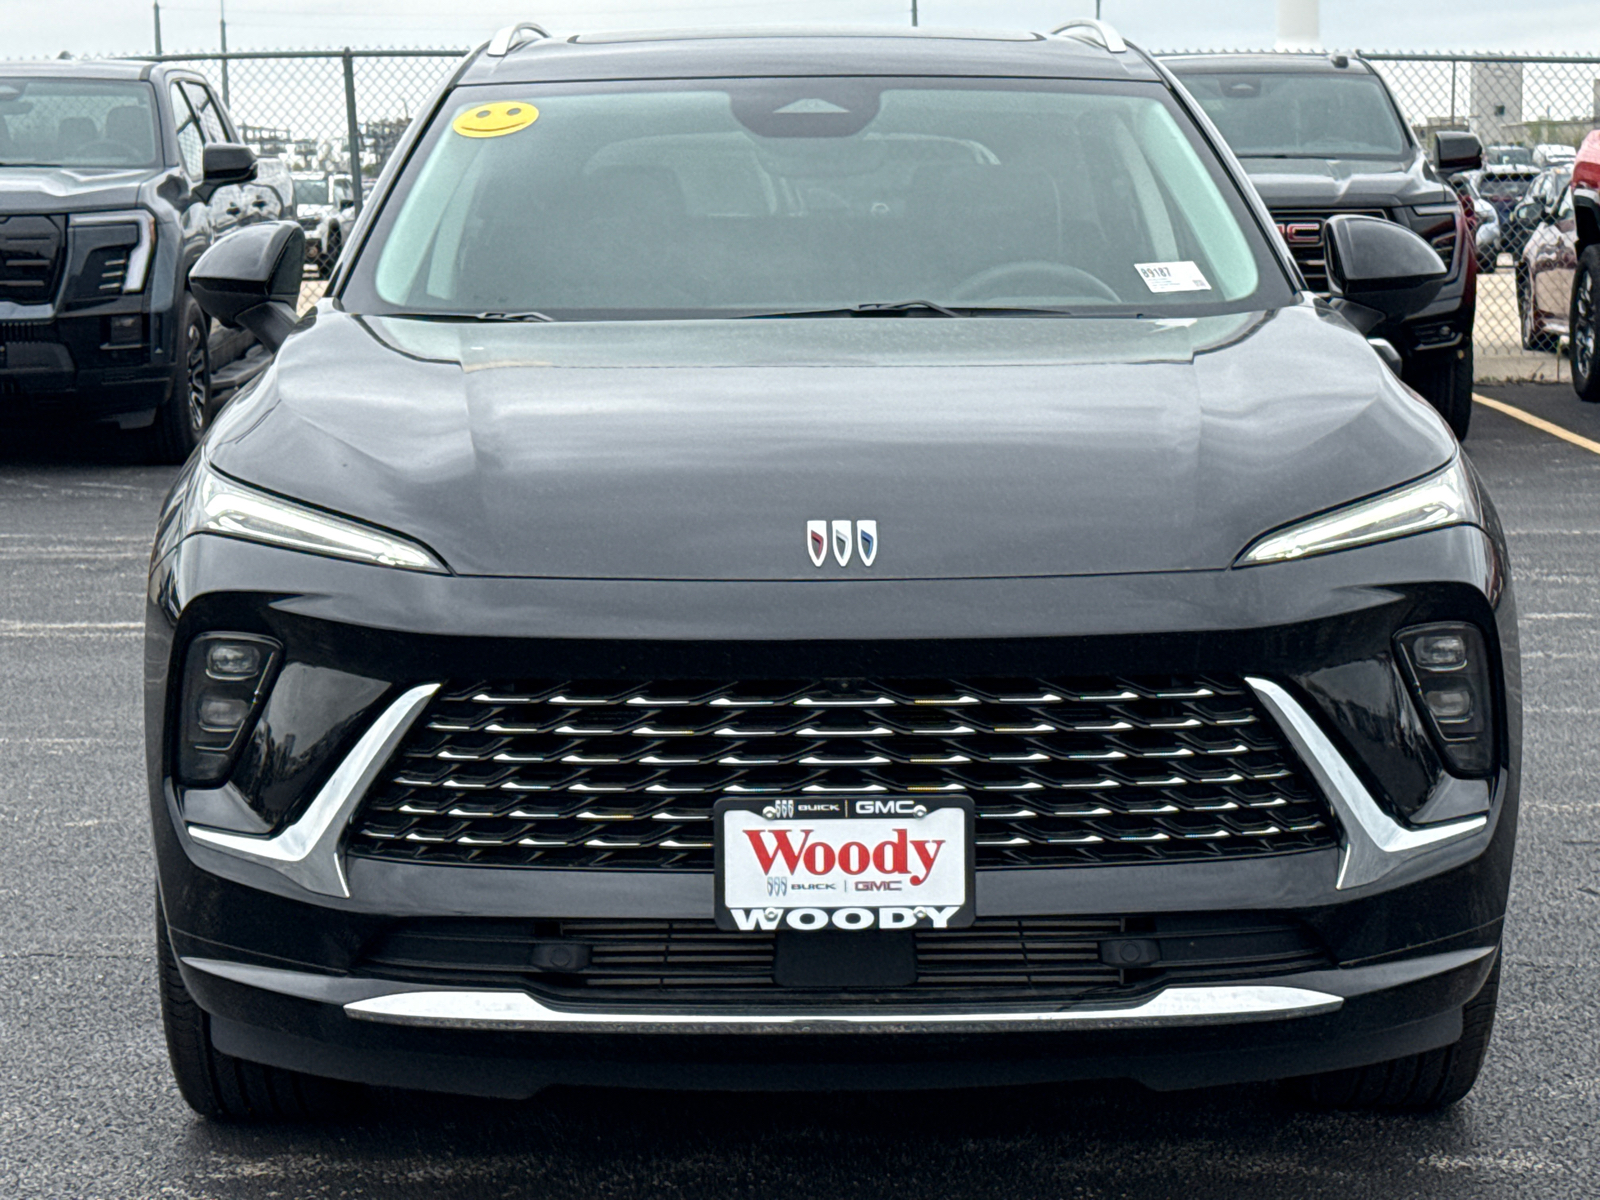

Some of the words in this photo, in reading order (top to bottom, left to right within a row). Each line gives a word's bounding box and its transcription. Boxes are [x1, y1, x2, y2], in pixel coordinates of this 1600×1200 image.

[798, 804, 840, 812] BUICK
[856, 801, 914, 814] GMC
[742, 828, 946, 886] Woody
[855, 881, 902, 891] GMC
[730, 907, 960, 930] WOODY
